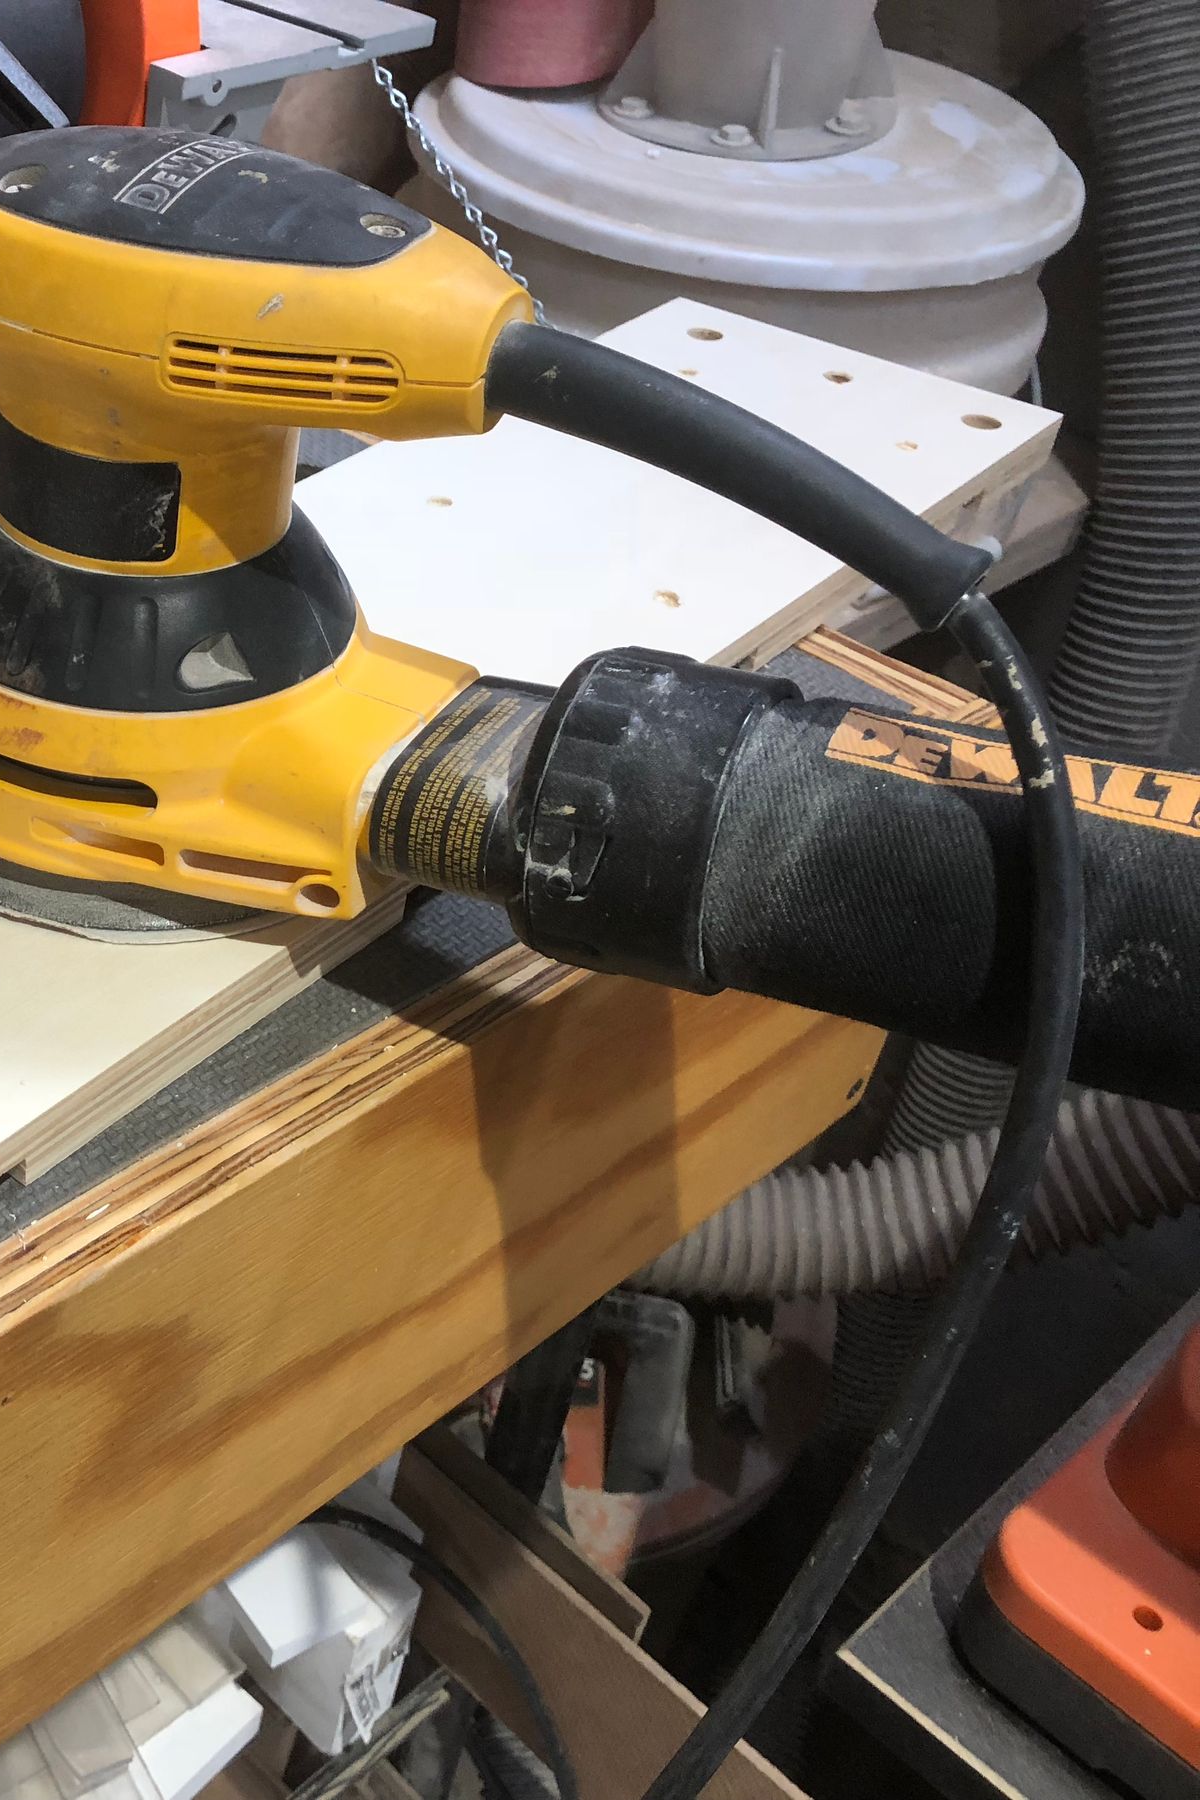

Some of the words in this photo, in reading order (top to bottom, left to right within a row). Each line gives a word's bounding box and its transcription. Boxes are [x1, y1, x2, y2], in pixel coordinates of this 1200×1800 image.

[380, 789, 397, 826] COATINGS
[389, 790, 405, 819] REDUCE
[409, 790, 428, 835] MATERIALES
[422, 781, 432, 791] DE
[416, 819, 426, 842] PUEDE
[421, 777, 442, 817] OCASIONAR
[433, 791, 445, 807] CON
[388, 820, 397, 829] TO
[426, 808, 439, 832] BOLSA
[435, 809, 447, 831] TIPOS
[441, 798, 451, 809] DE
[452, 809, 462, 819] DE
[463, 806, 481, 847] MINIMISER
[425, 834, 432, 843] LA
[454, 824, 466, 849] ENTRE
[475, 822, 484, 832] ET
[462, 848, 469, 858] DE
[469, 833, 482, 872] PONCEUSE
